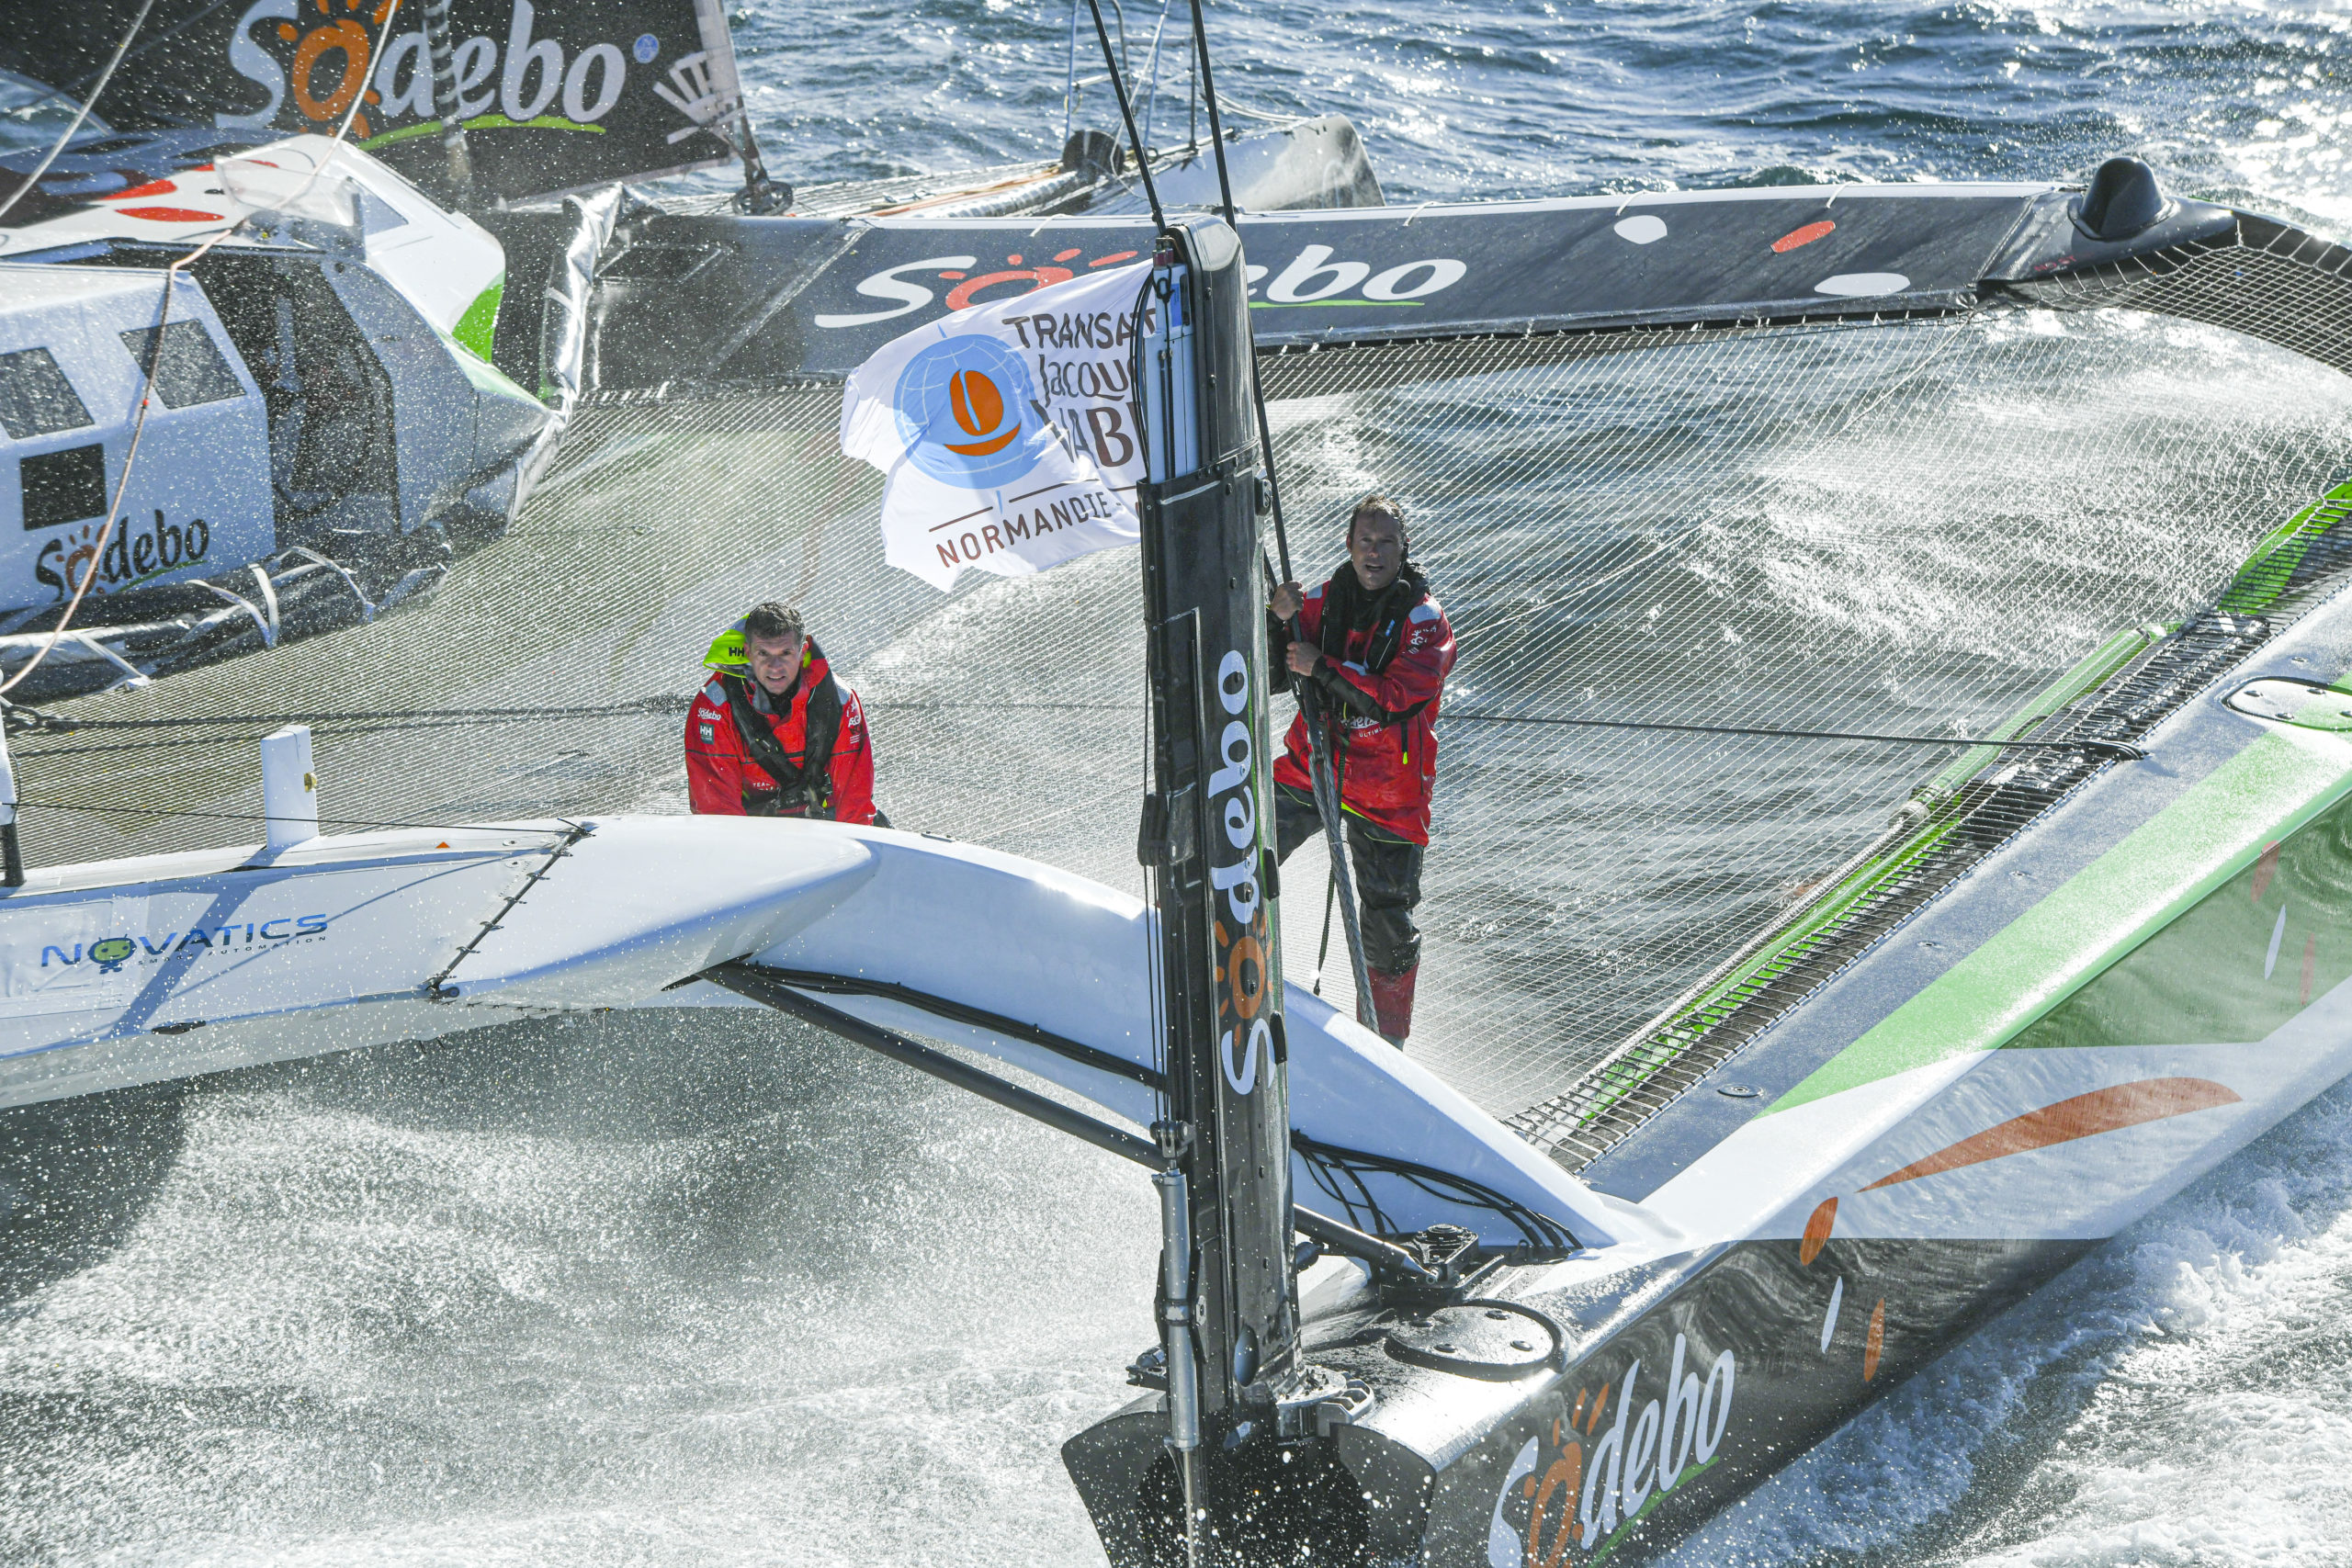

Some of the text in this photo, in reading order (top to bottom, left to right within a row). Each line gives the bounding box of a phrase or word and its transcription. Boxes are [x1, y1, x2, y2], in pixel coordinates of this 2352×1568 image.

[1002, 308, 1157, 349] TRANSAT
[936, 491, 1112, 568] NORMANDIE
[729, 647, 745, 657] HH
[700, 726, 712, 736] HH
[208, 935, 326, 956] AUTOMATION
